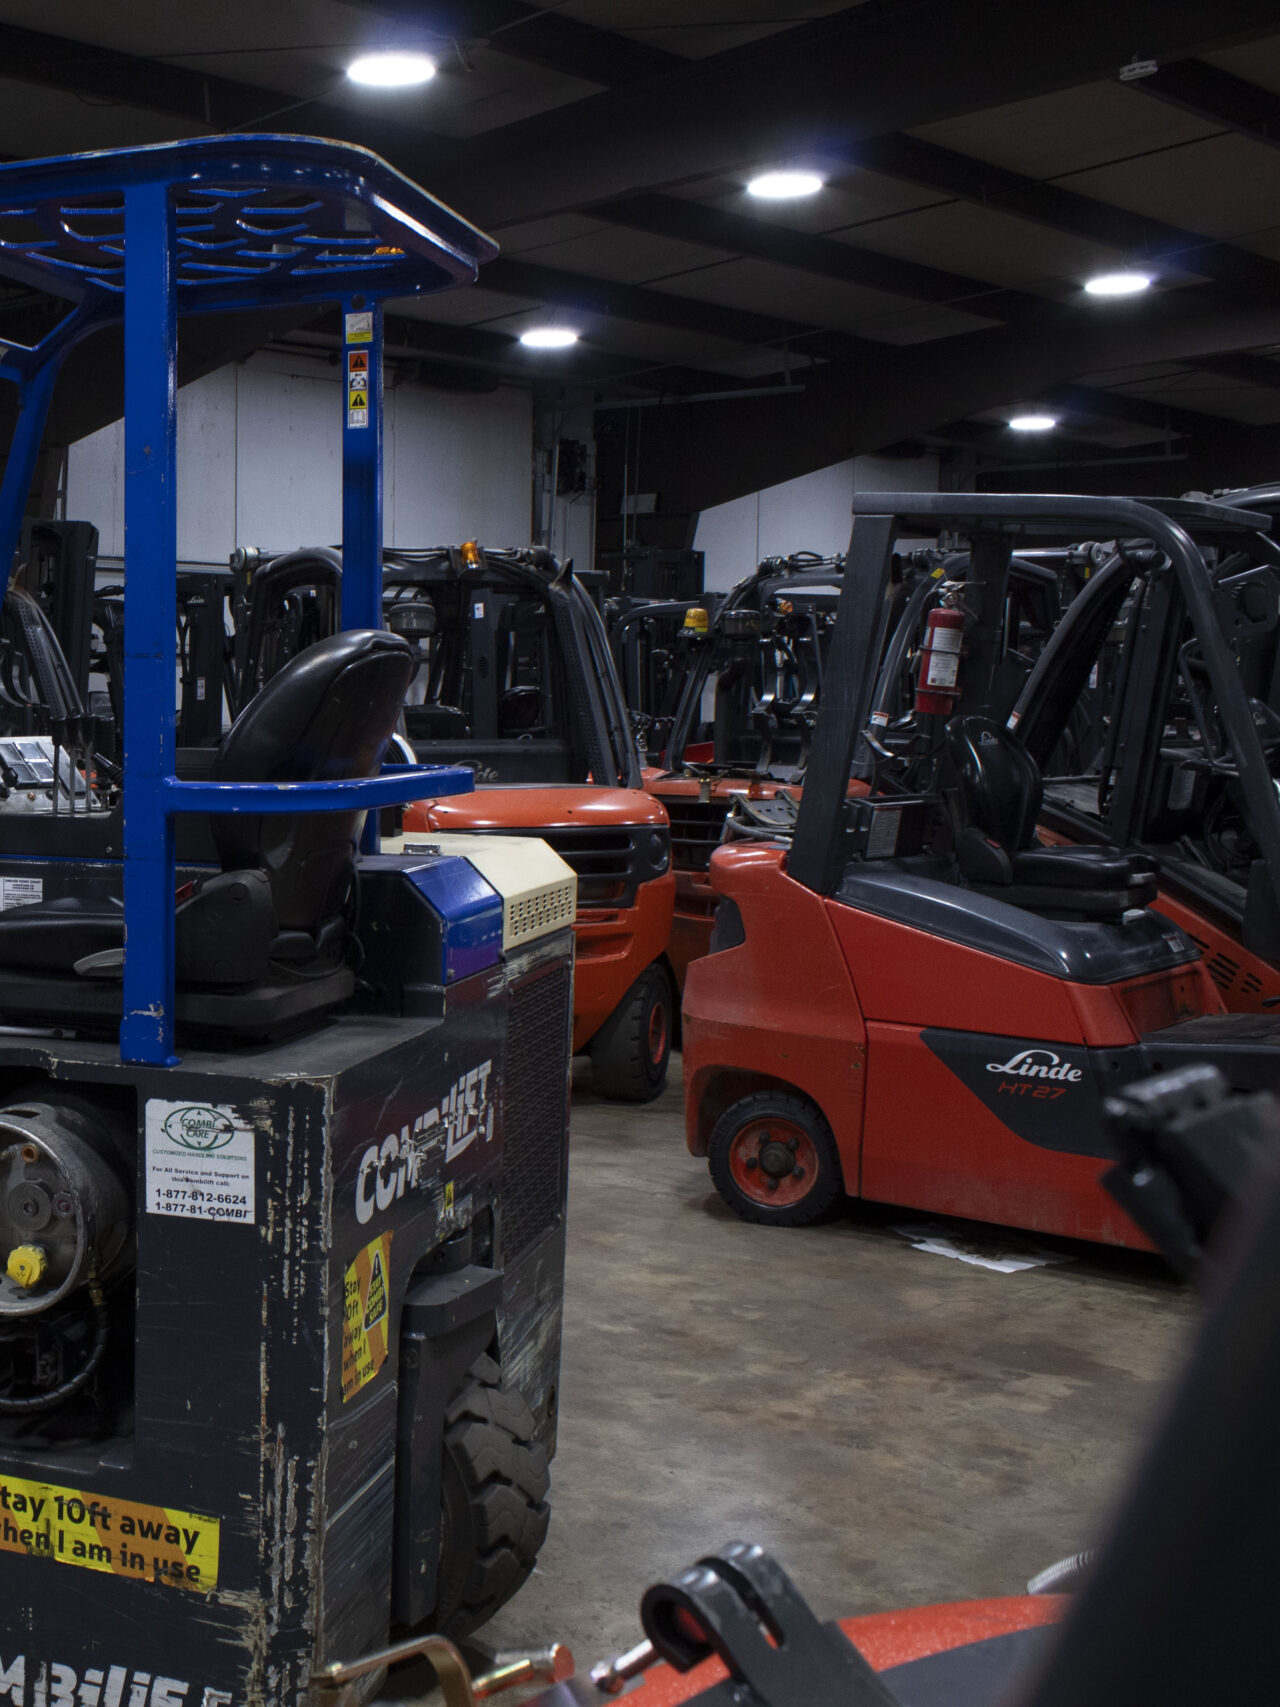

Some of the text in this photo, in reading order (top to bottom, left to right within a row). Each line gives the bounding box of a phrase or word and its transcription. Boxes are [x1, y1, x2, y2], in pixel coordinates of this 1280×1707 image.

[985, 1048, 1082, 1082] Linde
[187, 1129, 210, 1139] CARE
[152, 1149, 186, 1157] CUSTOMIZED
[187, 1151, 216, 1159] HANDLING
[156, 1189, 247, 1205] 1-877-812-6624
[156, 1202, 248, 1218] 1-877-81-COMBI
[344, 1278, 361, 1300] Stay
[344, 1298, 359, 1322] 0ft
[53, 1495, 112, 1531] 10ft
[119, 1514, 201, 1556] away
[58, 1529, 66, 1554] I
[71, 1536, 113, 1565] am
[119, 1542, 146, 1571] in
[152, 1556, 202, 1583] use
